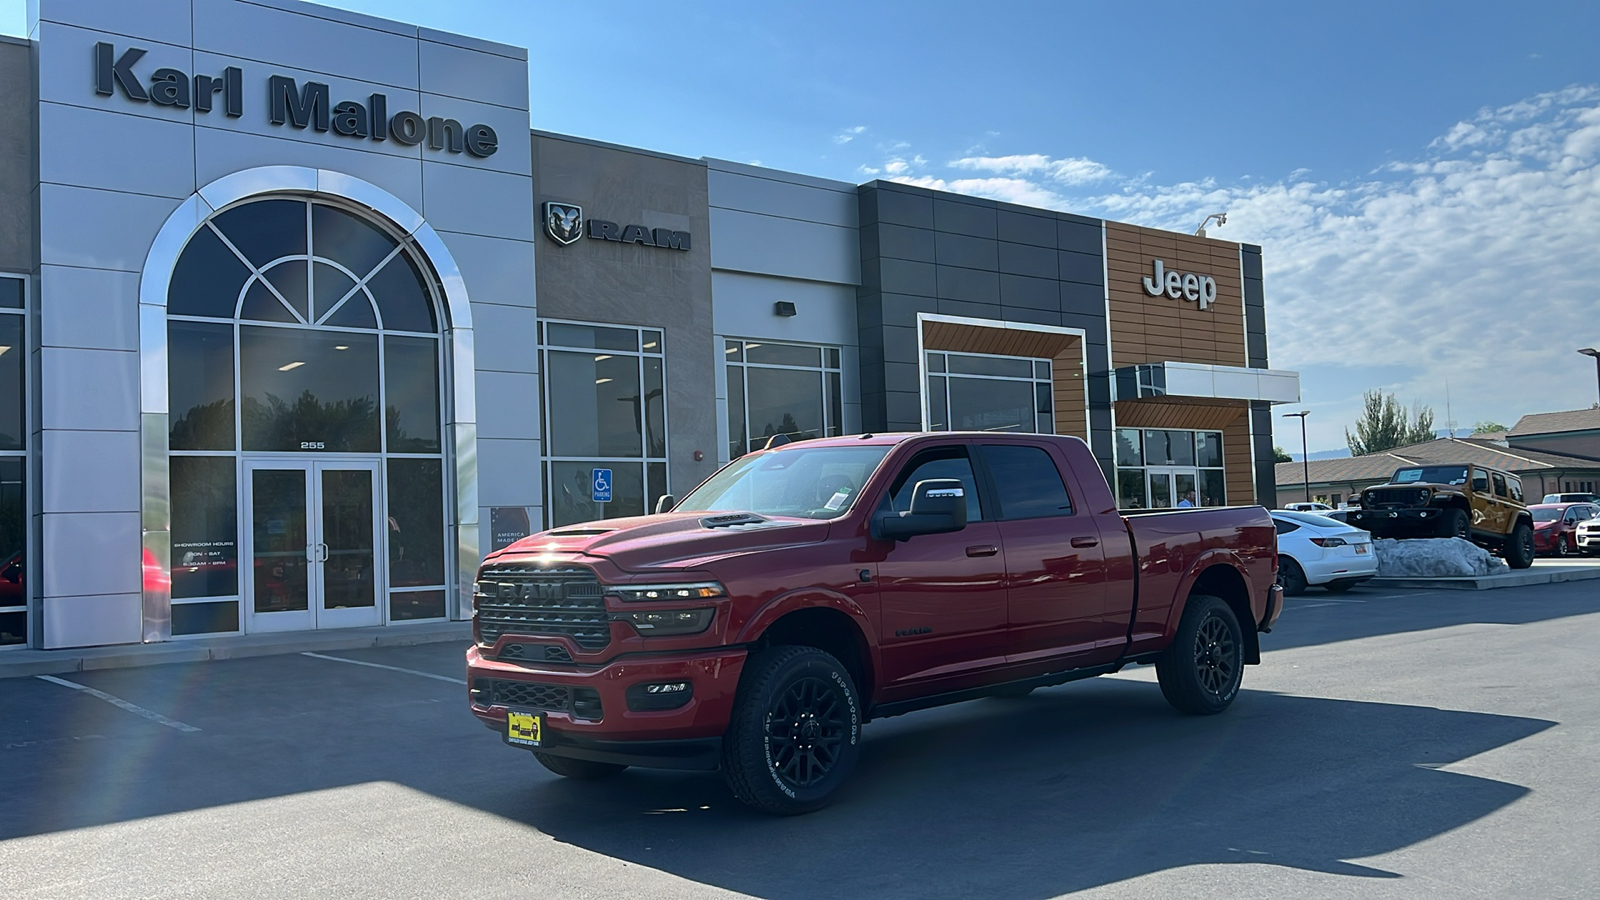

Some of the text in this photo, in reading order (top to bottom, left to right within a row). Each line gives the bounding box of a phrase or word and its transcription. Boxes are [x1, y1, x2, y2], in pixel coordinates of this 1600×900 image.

[94, 41, 499, 158] Karl Malone
[587, 218, 692, 251] RAM
[1142, 258, 1217, 310] Jeep
[300, 441, 325, 450] 255
[497, 582, 564, 600] RAM
